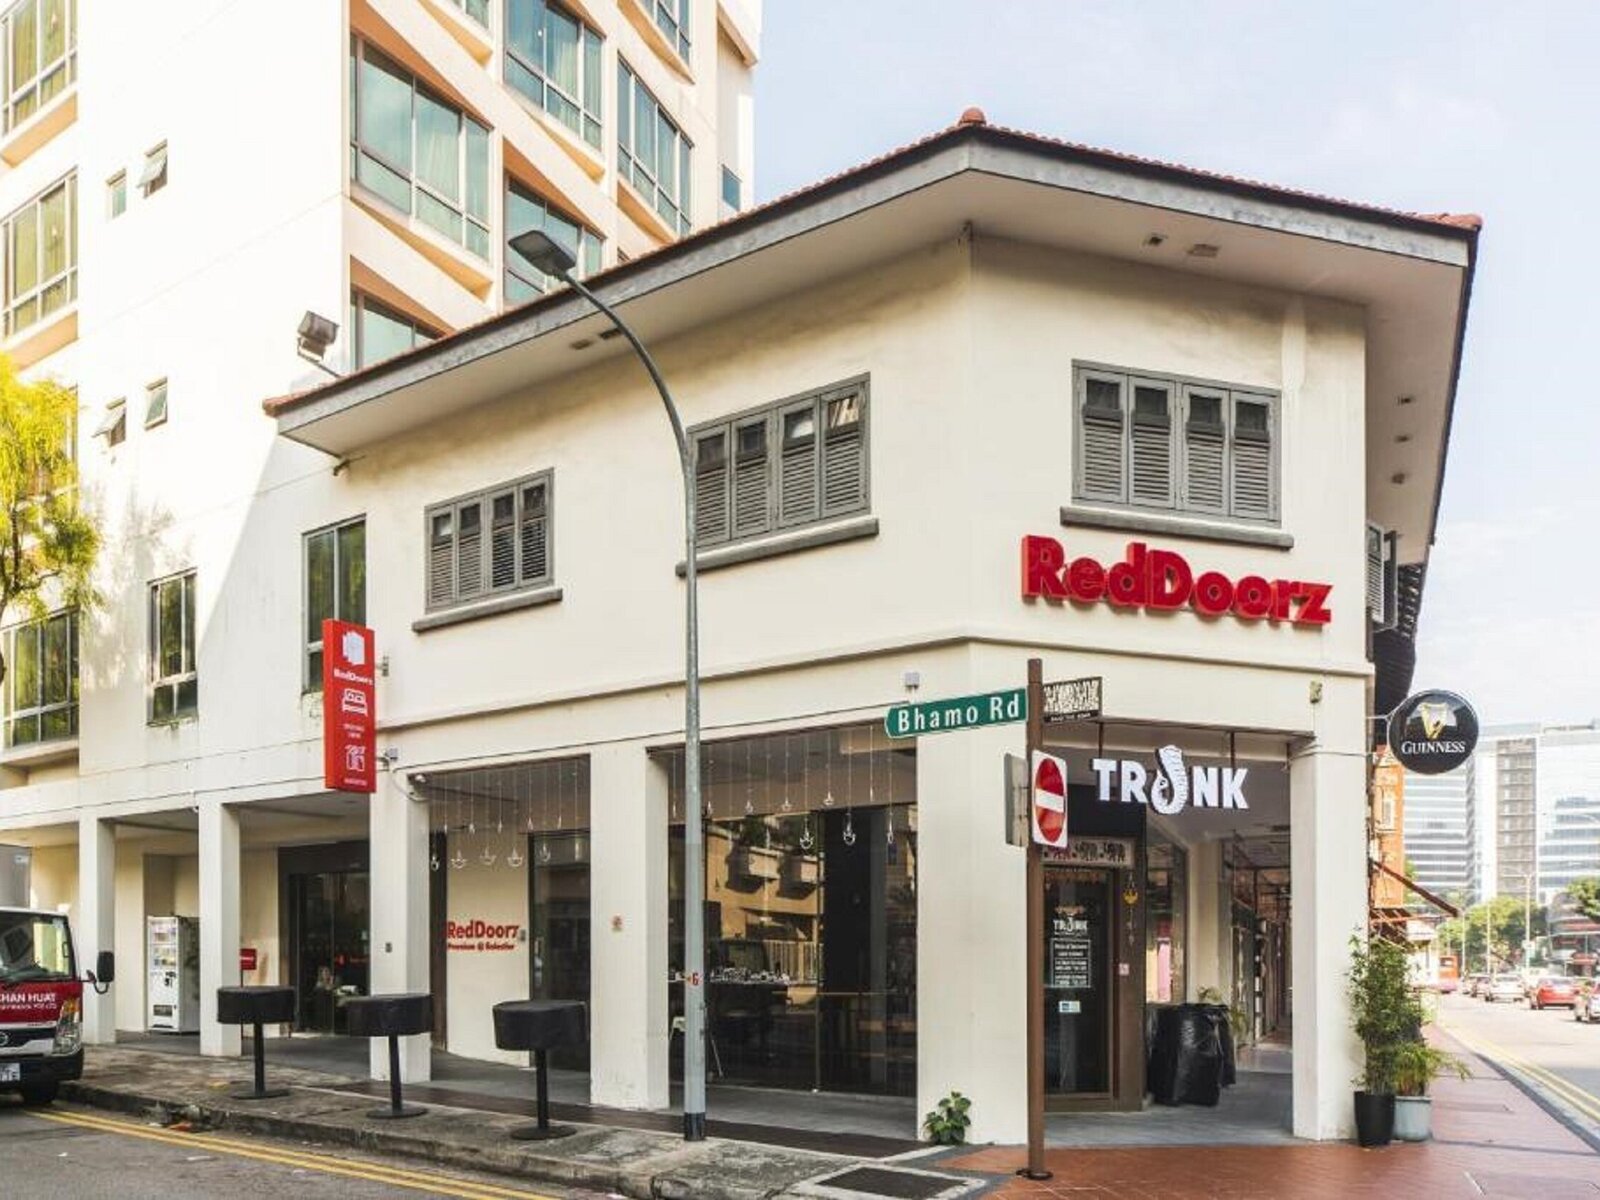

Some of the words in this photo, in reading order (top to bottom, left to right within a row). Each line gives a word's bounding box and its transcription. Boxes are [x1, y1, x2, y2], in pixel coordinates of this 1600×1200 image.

[1022, 535, 1333, 625] RedDoorz
[897, 705, 979, 733] Bhamo
[989, 693, 1020, 721] Rd
[1401, 740, 1467, 754] GUINNESS
